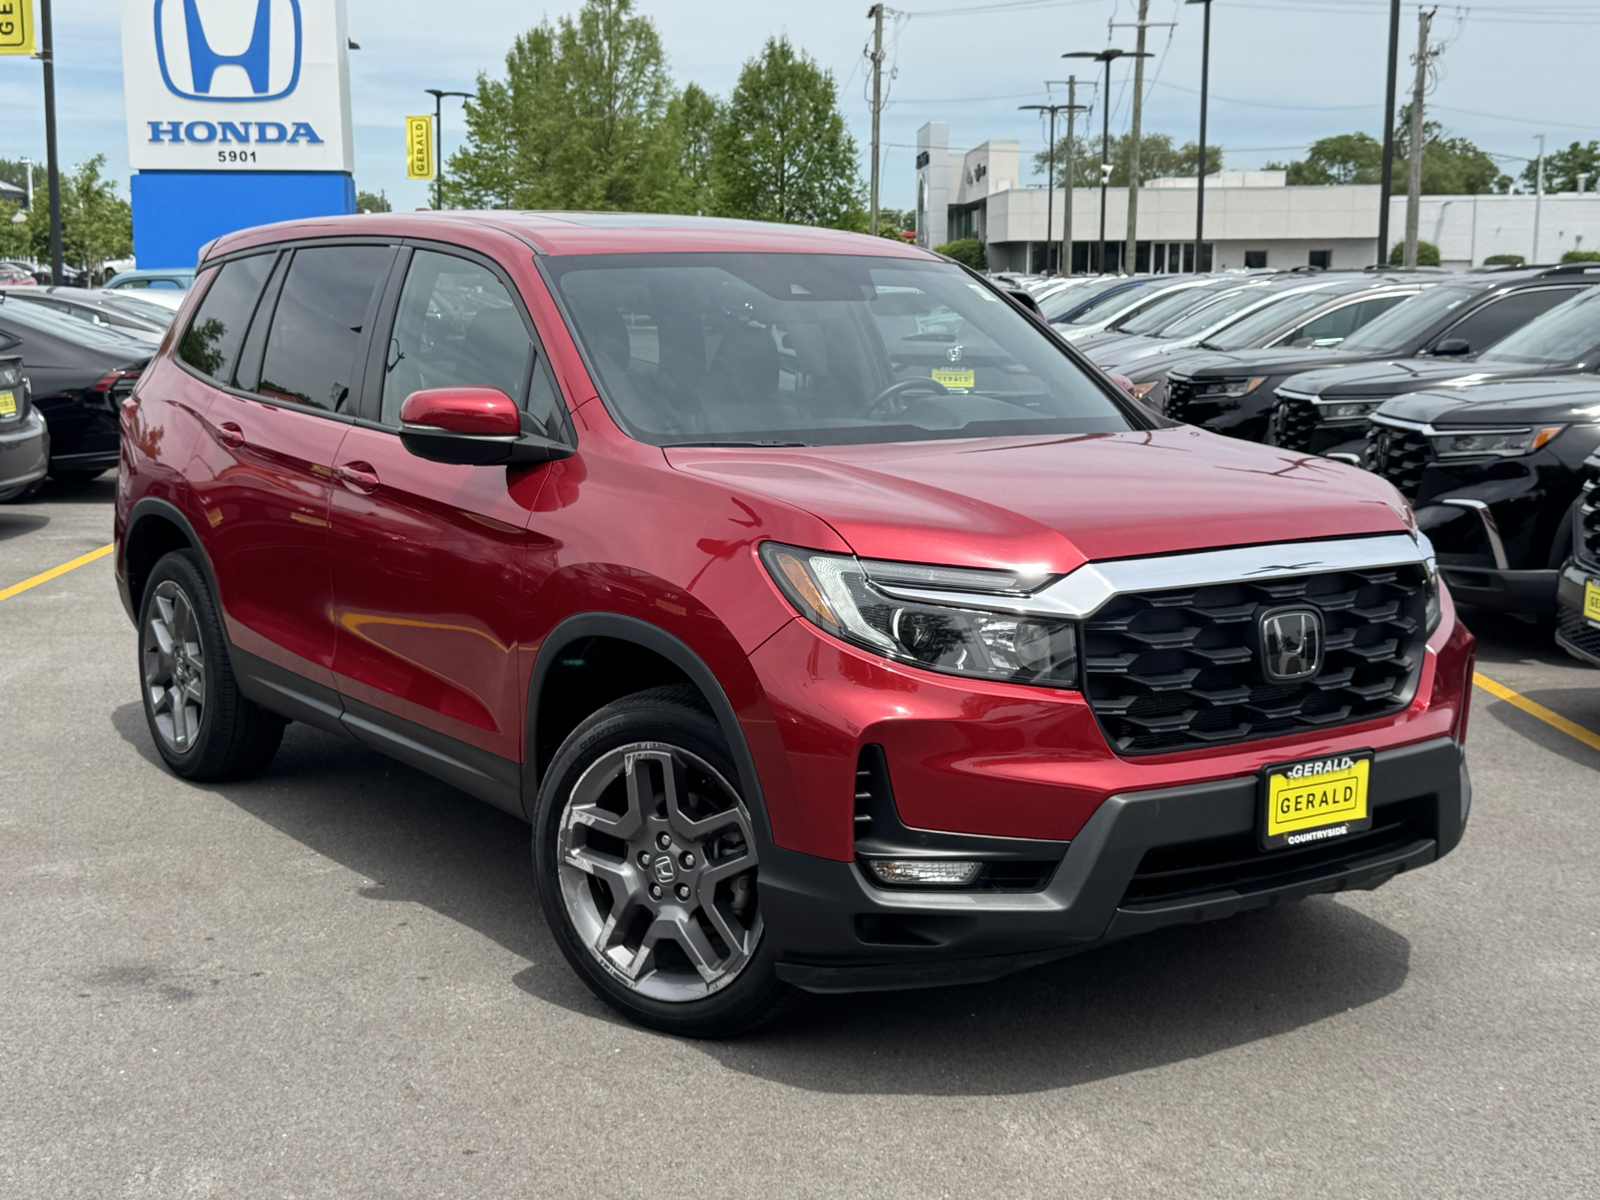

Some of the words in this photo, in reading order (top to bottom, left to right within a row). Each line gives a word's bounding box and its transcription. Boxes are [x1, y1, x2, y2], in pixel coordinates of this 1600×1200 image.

[147, 121, 325, 143] HONDA
[218, 150, 257, 163] 5901
[415, 123, 425, 172] GERALD
[1292, 757, 1351, 778] GERALD
[1281, 785, 1353, 814] GERALD
[1287, 825, 1348, 845] COUNTRYSIDE
